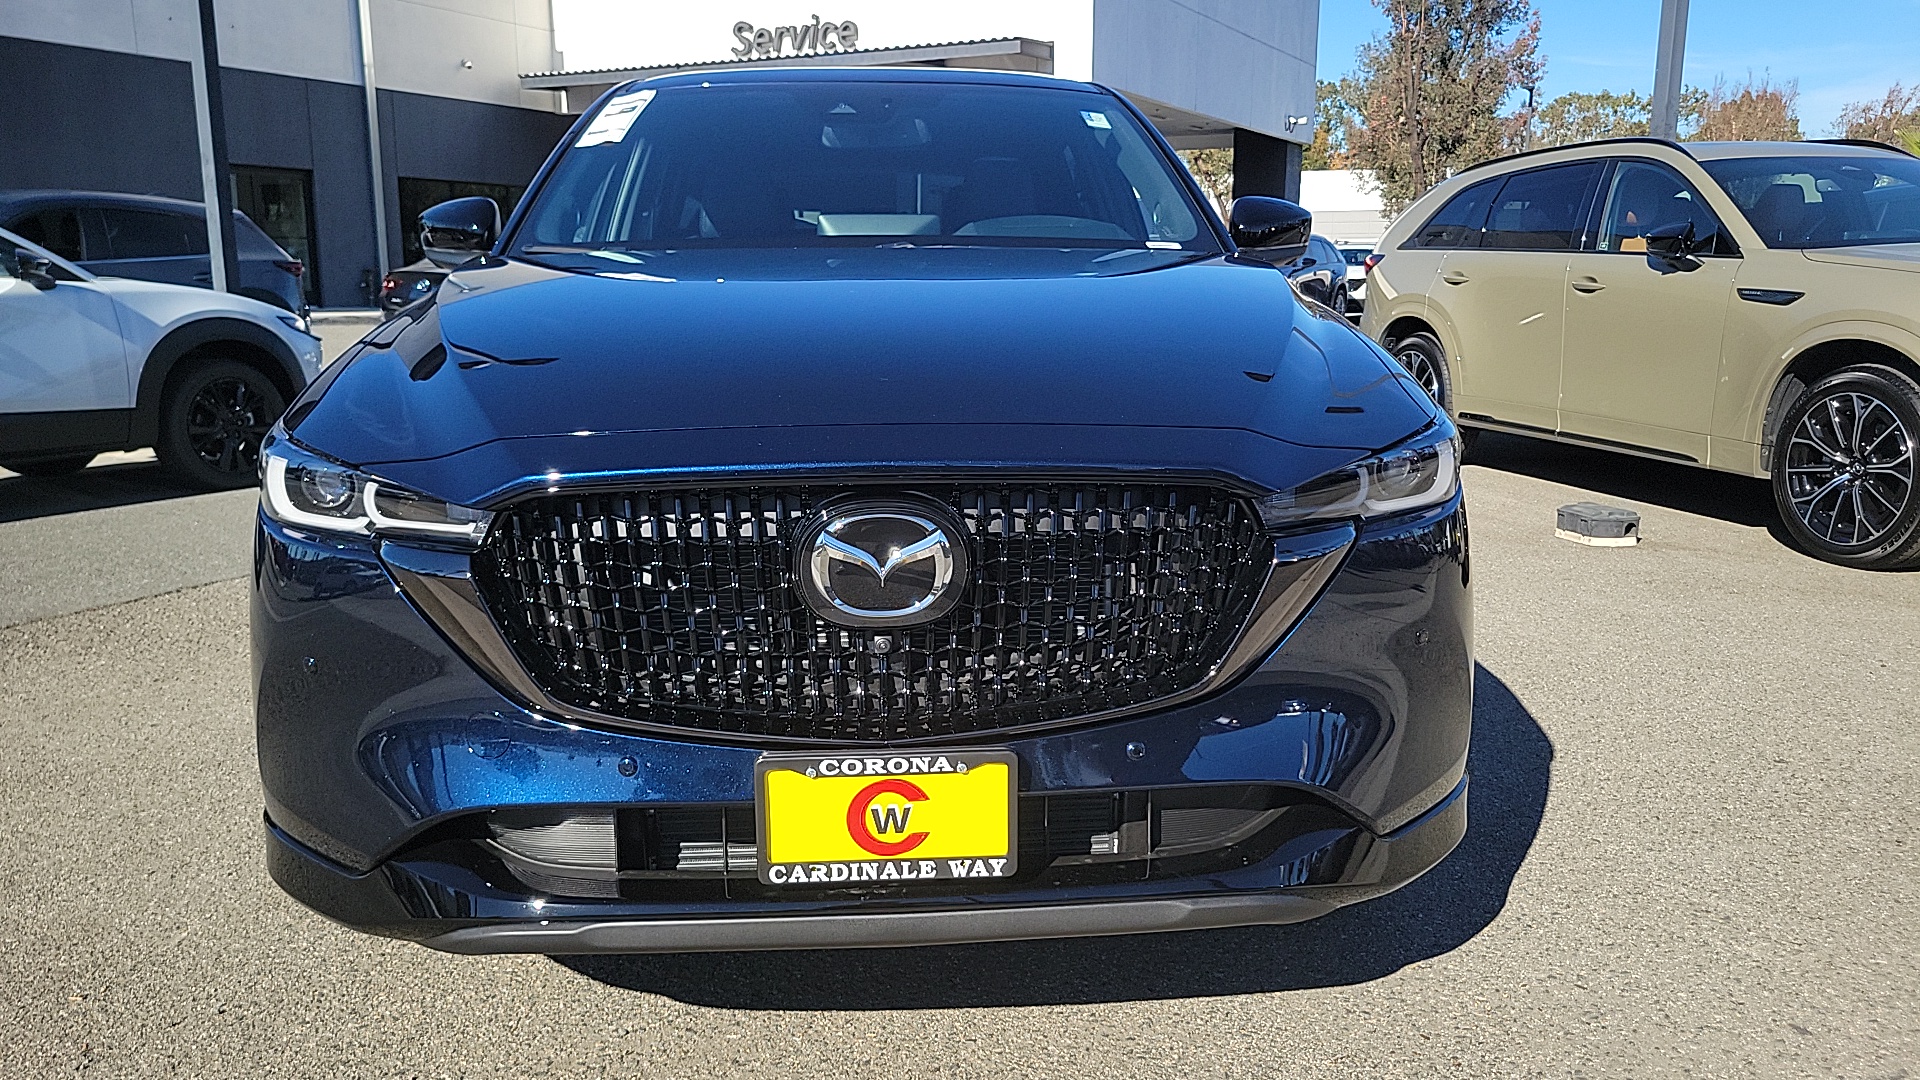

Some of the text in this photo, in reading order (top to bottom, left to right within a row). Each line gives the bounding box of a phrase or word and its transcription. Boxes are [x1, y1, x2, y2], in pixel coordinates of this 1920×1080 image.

[731, 14, 859, 57] Service
[818, 756, 954, 776] CORONA
[768, 858, 1008, 884] CARDINALE WAY
